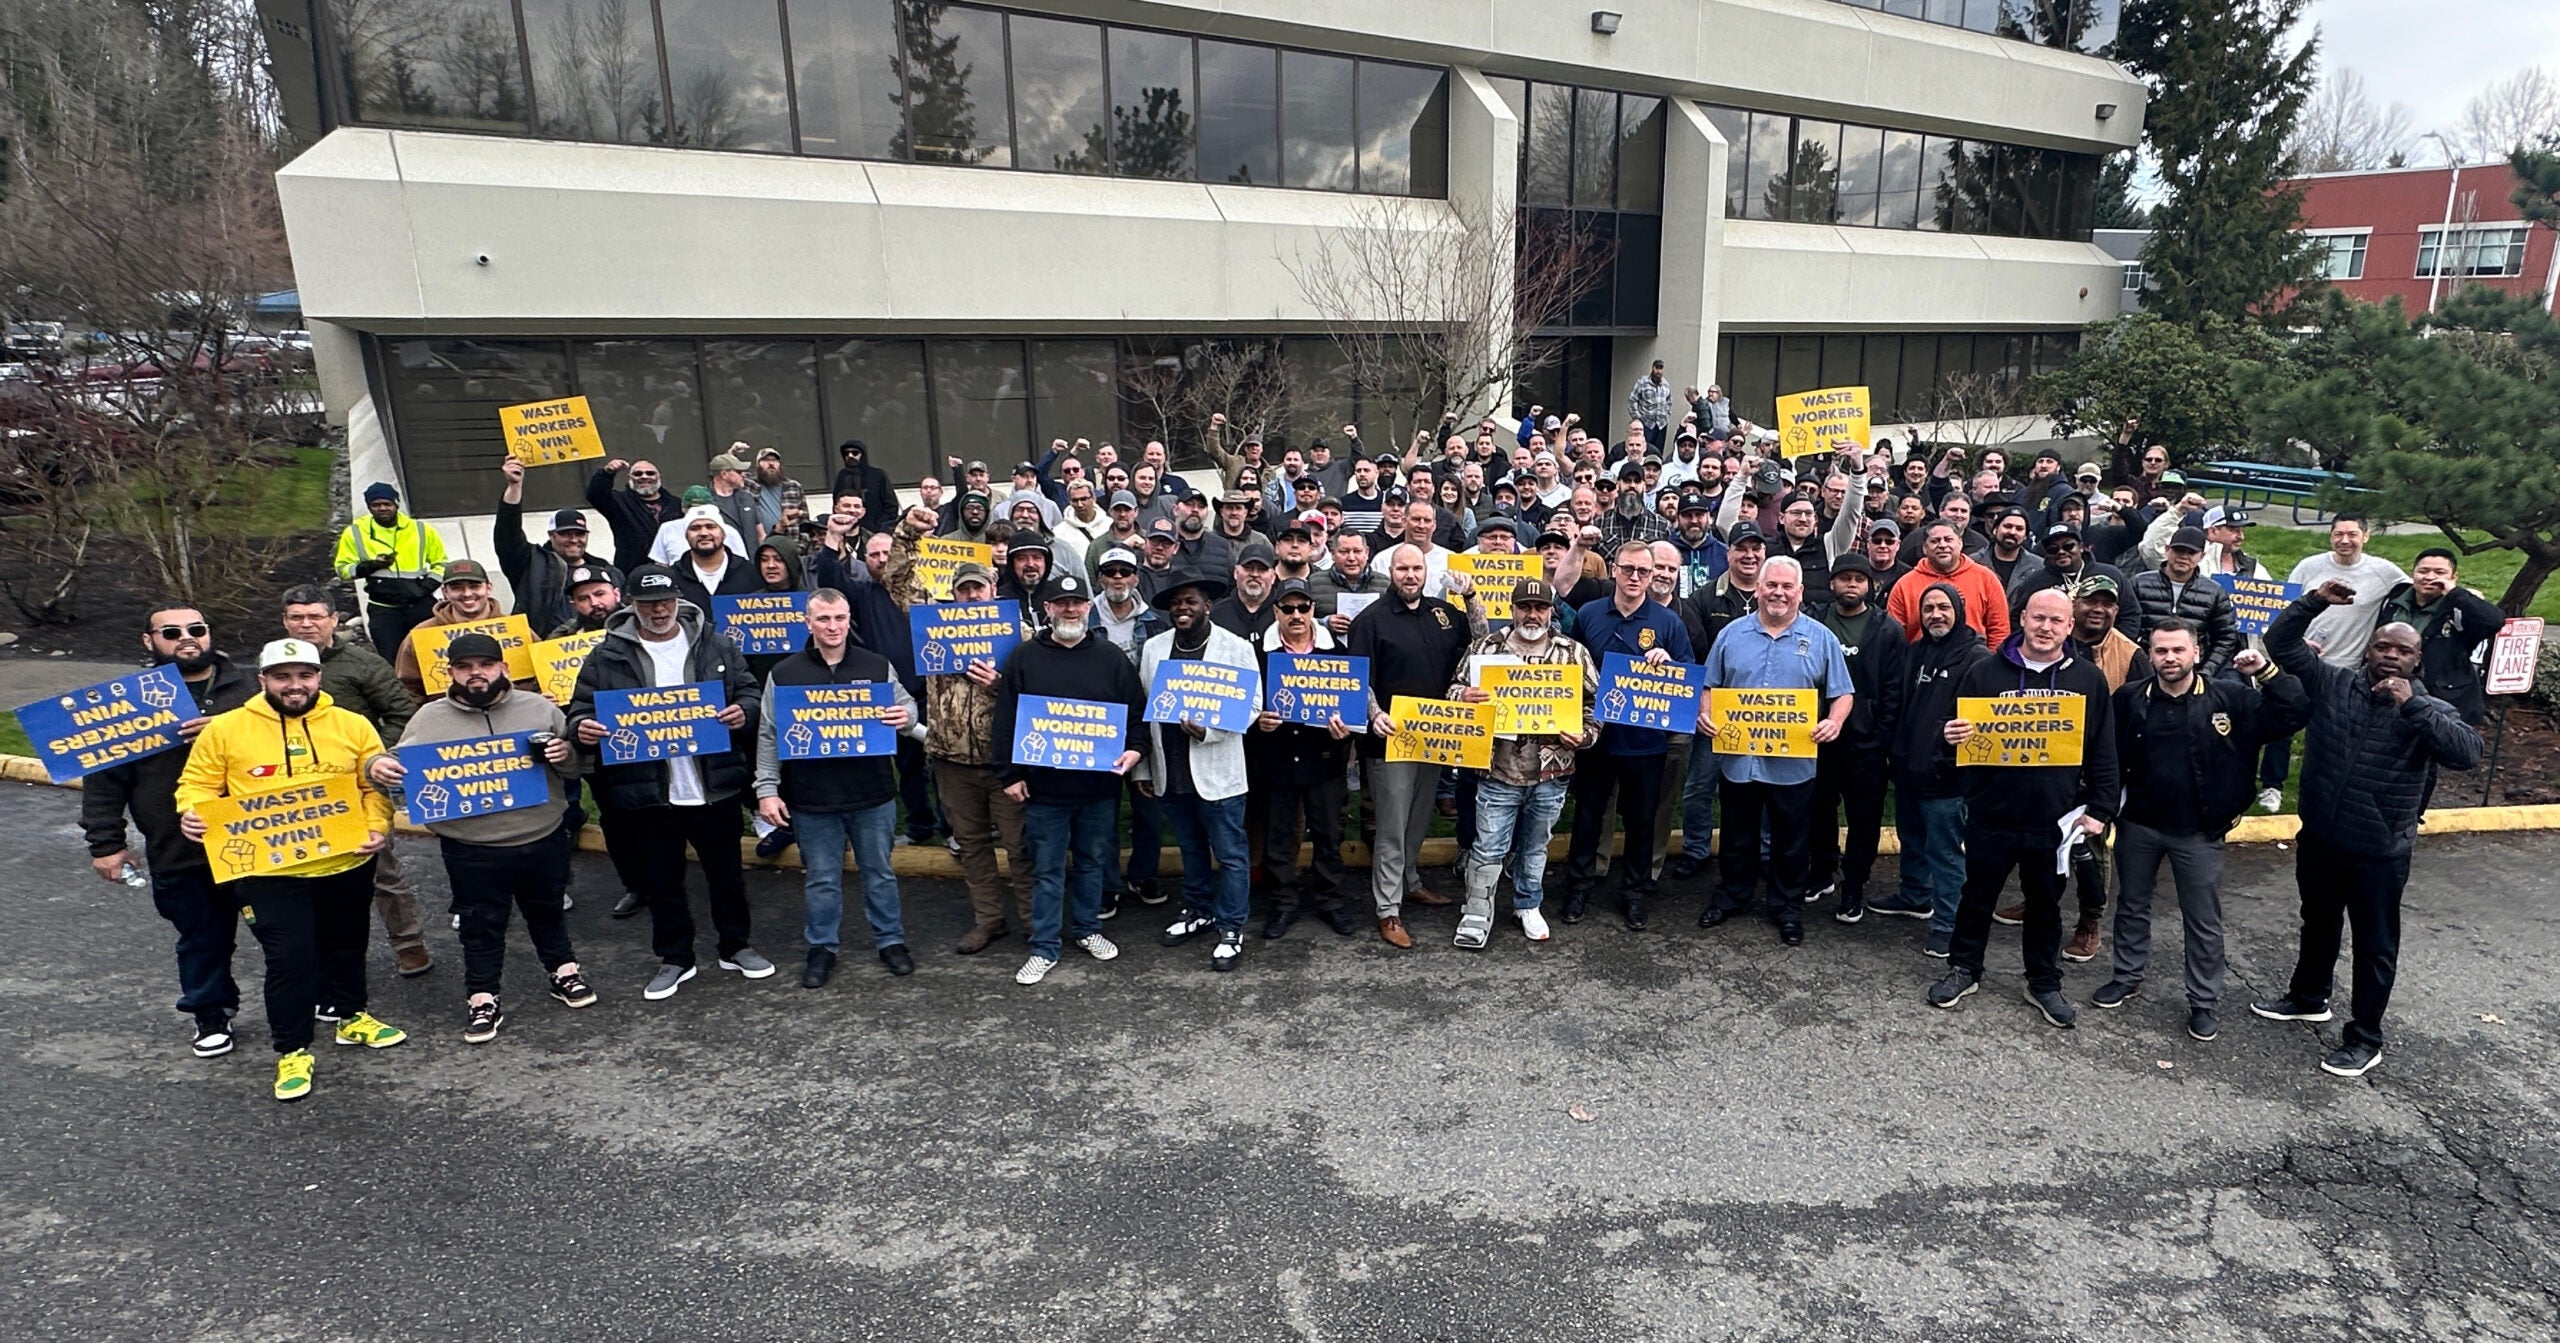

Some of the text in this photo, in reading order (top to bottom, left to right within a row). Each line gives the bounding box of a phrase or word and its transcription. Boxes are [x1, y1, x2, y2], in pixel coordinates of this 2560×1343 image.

[1801, 392, 1853, 407] WASTE
[522, 403, 570, 419] WASTE
[1791, 407, 1864, 424] WORKERS
[515, 417, 587, 436] WORKERS
[1812, 424, 1847, 436] WIN!
[537, 435, 572, 448] WIN!
[927, 543, 975, 557] WASTE
[1472, 558, 1524, 571] WASTE
[2233, 580, 2285, 596] WASTE
[737, 597, 792, 609] WASTE
[1480, 591, 1509, 602] WIN
[726, 612, 805, 625] WORKERS
[938, 606, 999, 621] WASTE
[2236, 608, 2270, 621] WIN!
[749, 628, 787, 639] WIN!
[926, 622, 1013, 640] WORKERS
[284, 642, 296, 656] S
[951, 642, 992, 656] WIN!
[2502, 638, 2531, 655] FIRE
[1181, 664, 1238, 682] WASTE
[1293, 658, 1349, 673] WASTE
[1629, 660, 1686, 680] WASTE
[2495, 657, 2529, 675] LANE
[1281, 674, 1360, 690] WORKERS
[1507, 670, 1562, 681] WASTE
[1166, 679, 1246, 700] WORKERS
[1493, 686, 1573, 699] WORKERS
[1614, 675, 1694, 698] WORKERS
[628, 688, 700, 707] WASTE
[805, 688, 871, 703] WASTE
[1182, 695, 1221, 711] WIN!
[1300, 693, 1339, 707] WIN!
[1738, 694, 1796, 706] WASTE
[1046, 701, 1107, 719] WASTE
[1417, 703, 1475, 719] WASTE
[1515, 704, 1552, 716] WIN!
[1633, 696, 1670, 712] WIN!
[1990, 703, 2060, 716] WASTE
[73, 700, 137, 726] WIN!
[615, 704, 716, 727] WORKERS
[792, 706, 886, 722] WORKERS
[1725, 710, 1808, 723] WORKERS
[49, 710, 179, 754] WORKERS
[645, 726, 693, 741] WIN!
[818, 725, 862, 739] WIN!
[1031, 718, 1117, 738] WORKERS
[1403, 720, 1485, 737] WORKERS
[1747, 727, 1786, 740] WIN!
[1976, 720, 2074, 733] WORKERS
[78, 734, 170, 768] WASTE
[437, 739, 516, 761] WASTE
[1053, 738, 1094, 753] WIN!
[1424, 737, 1461, 750] WIN!
[2001, 738, 2047, 749] WIN!
[423, 754, 533, 781] WORKERS
[456, 778, 508, 797] WIN!
[239, 785, 327, 813] WASTE
[224, 801, 350, 835] WORKERS
[264, 825, 322, 848] WIN!
